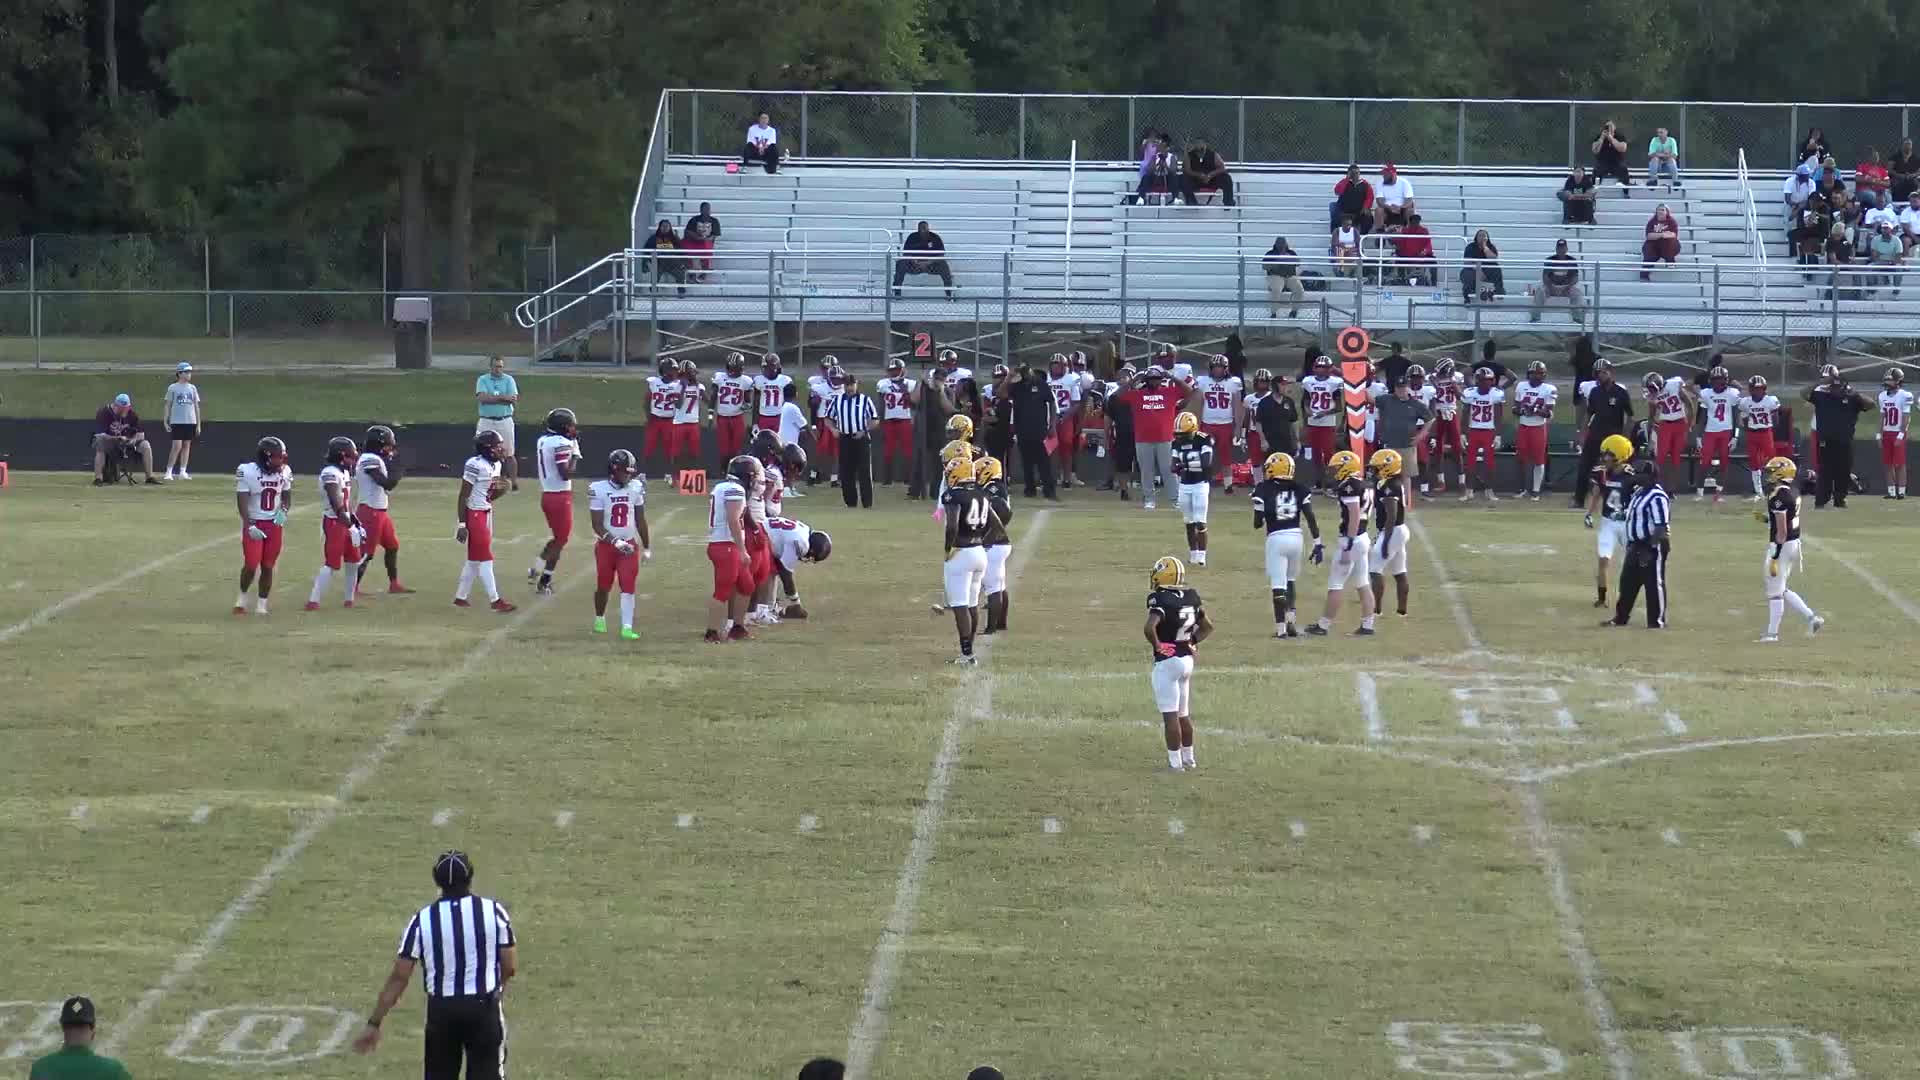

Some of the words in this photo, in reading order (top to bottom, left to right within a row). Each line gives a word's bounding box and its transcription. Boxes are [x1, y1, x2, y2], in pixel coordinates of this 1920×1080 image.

[914, 333, 931, 356] 2
[1311, 392, 1332, 410] 26
[1715, 404, 1725, 422] 4
[682, 473, 704, 494] 40
[260, 488, 277, 511] 0
[610, 503, 629, 528] 8
[1175, 605, 1195, 641] 2
